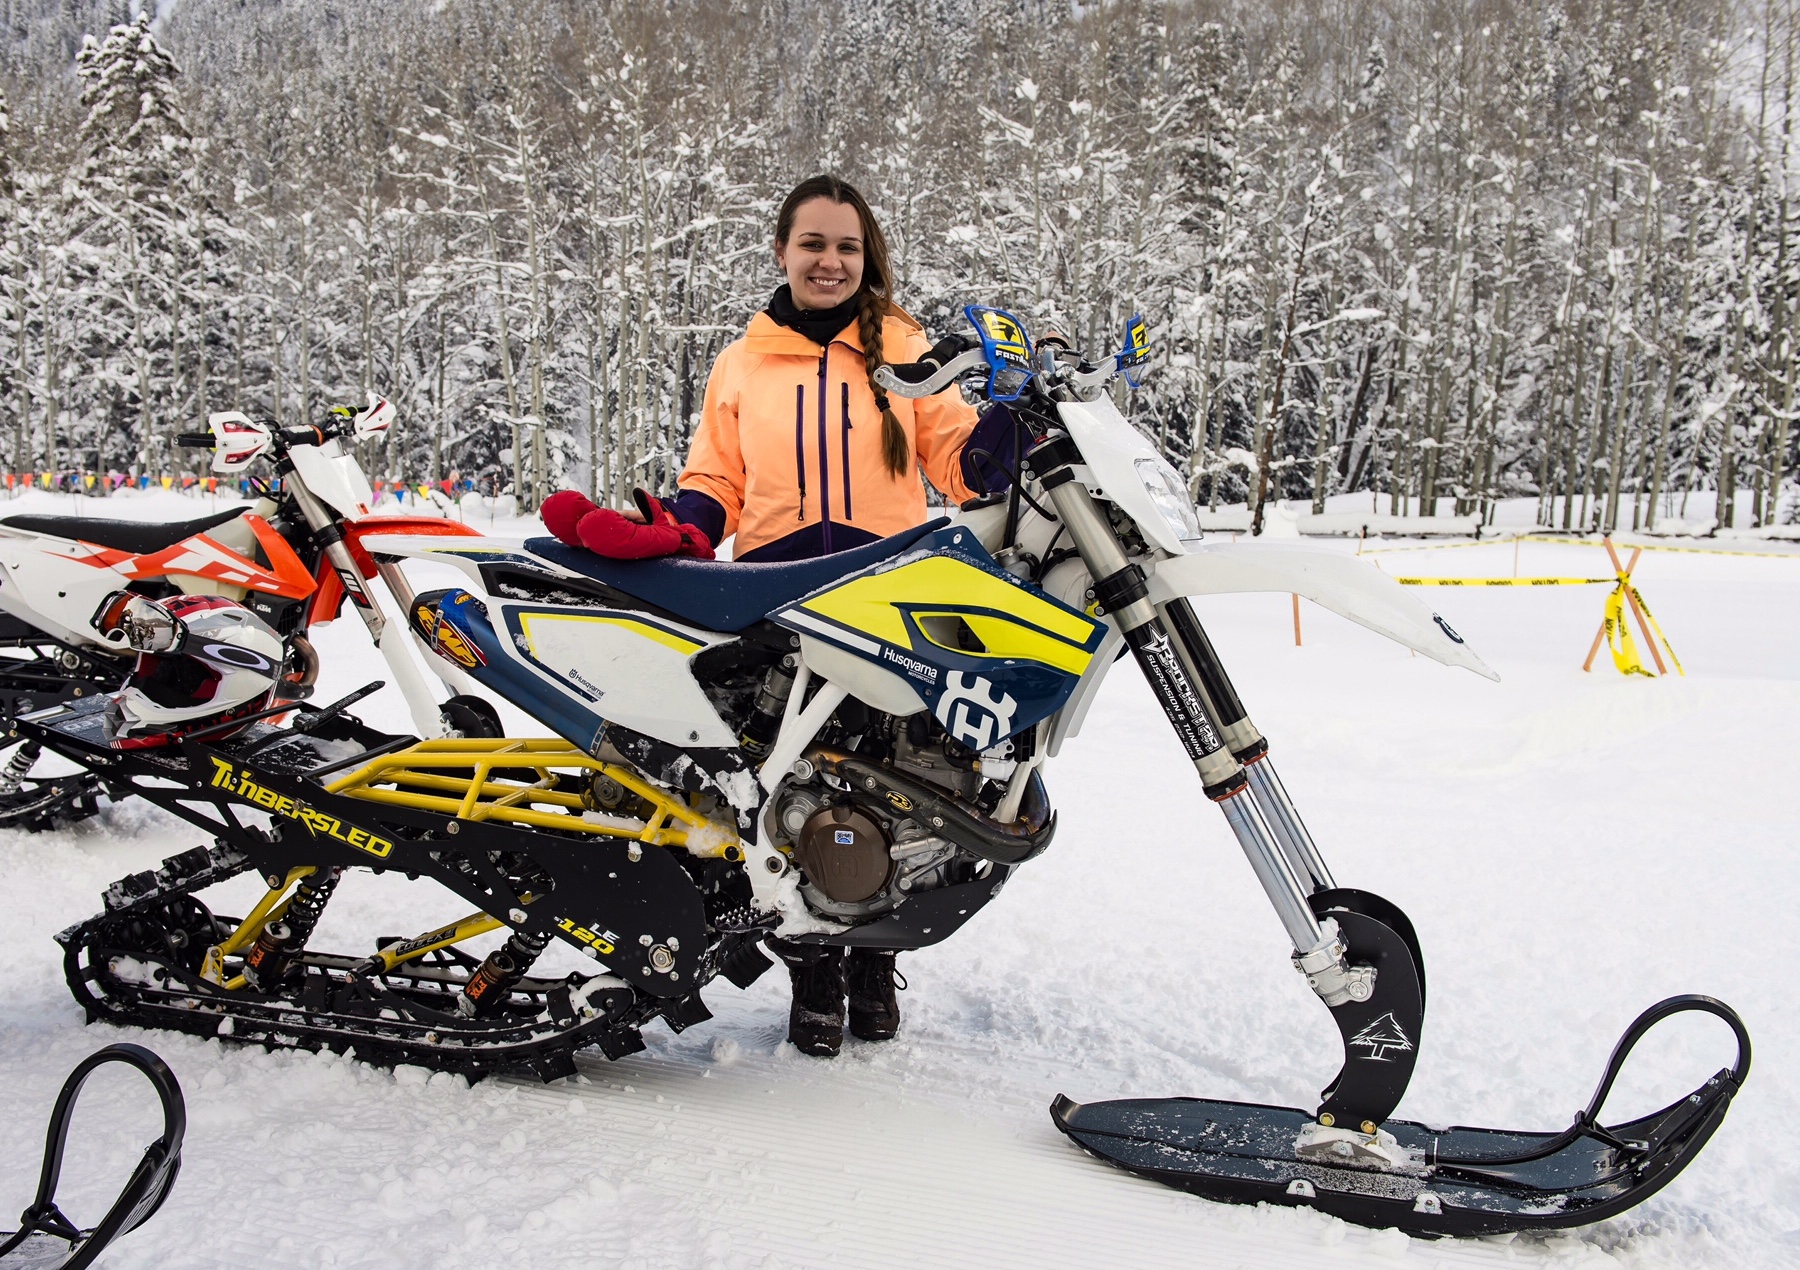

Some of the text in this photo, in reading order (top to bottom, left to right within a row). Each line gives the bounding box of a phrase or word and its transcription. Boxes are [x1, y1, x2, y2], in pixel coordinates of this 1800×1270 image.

[883, 647, 938, 679] Husqvarna
[575, 673, 605, 697] Husqvarna
[907, 671, 936, 686] MOTORCYCLES
[1147, 654, 1181, 712] SUSPENSION
[1183, 723, 1205, 756] TUNING
[558, 917, 615, 954] 120
[589, 922, 620, 944] LE
